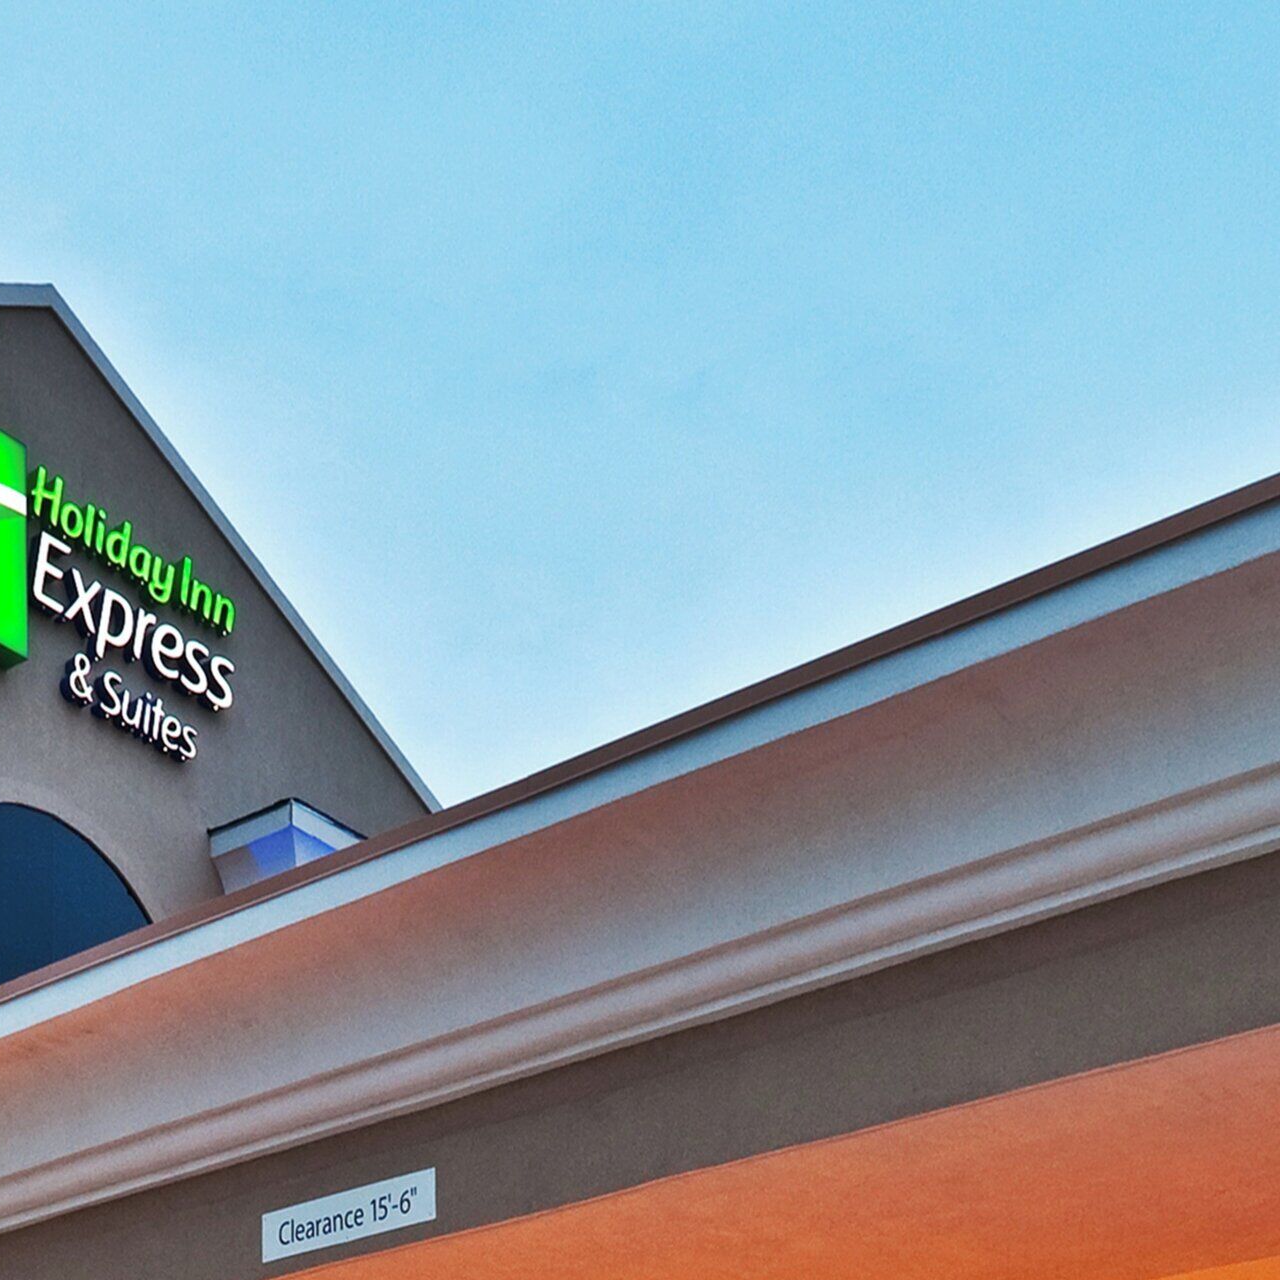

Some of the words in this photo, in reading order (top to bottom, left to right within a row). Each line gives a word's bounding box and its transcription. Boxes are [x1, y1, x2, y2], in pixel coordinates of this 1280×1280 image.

[31, 465, 176, 604] Holiday
[180, 556, 236, 633] Inn
[32, 530, 235, 709] Express
[69, 652, 94, 703] &
[99, 670, 198, 760] Suites
[278, 1207, 365, 1246] Clearance
[370, 1186, 418, 1222] 15'-6"
